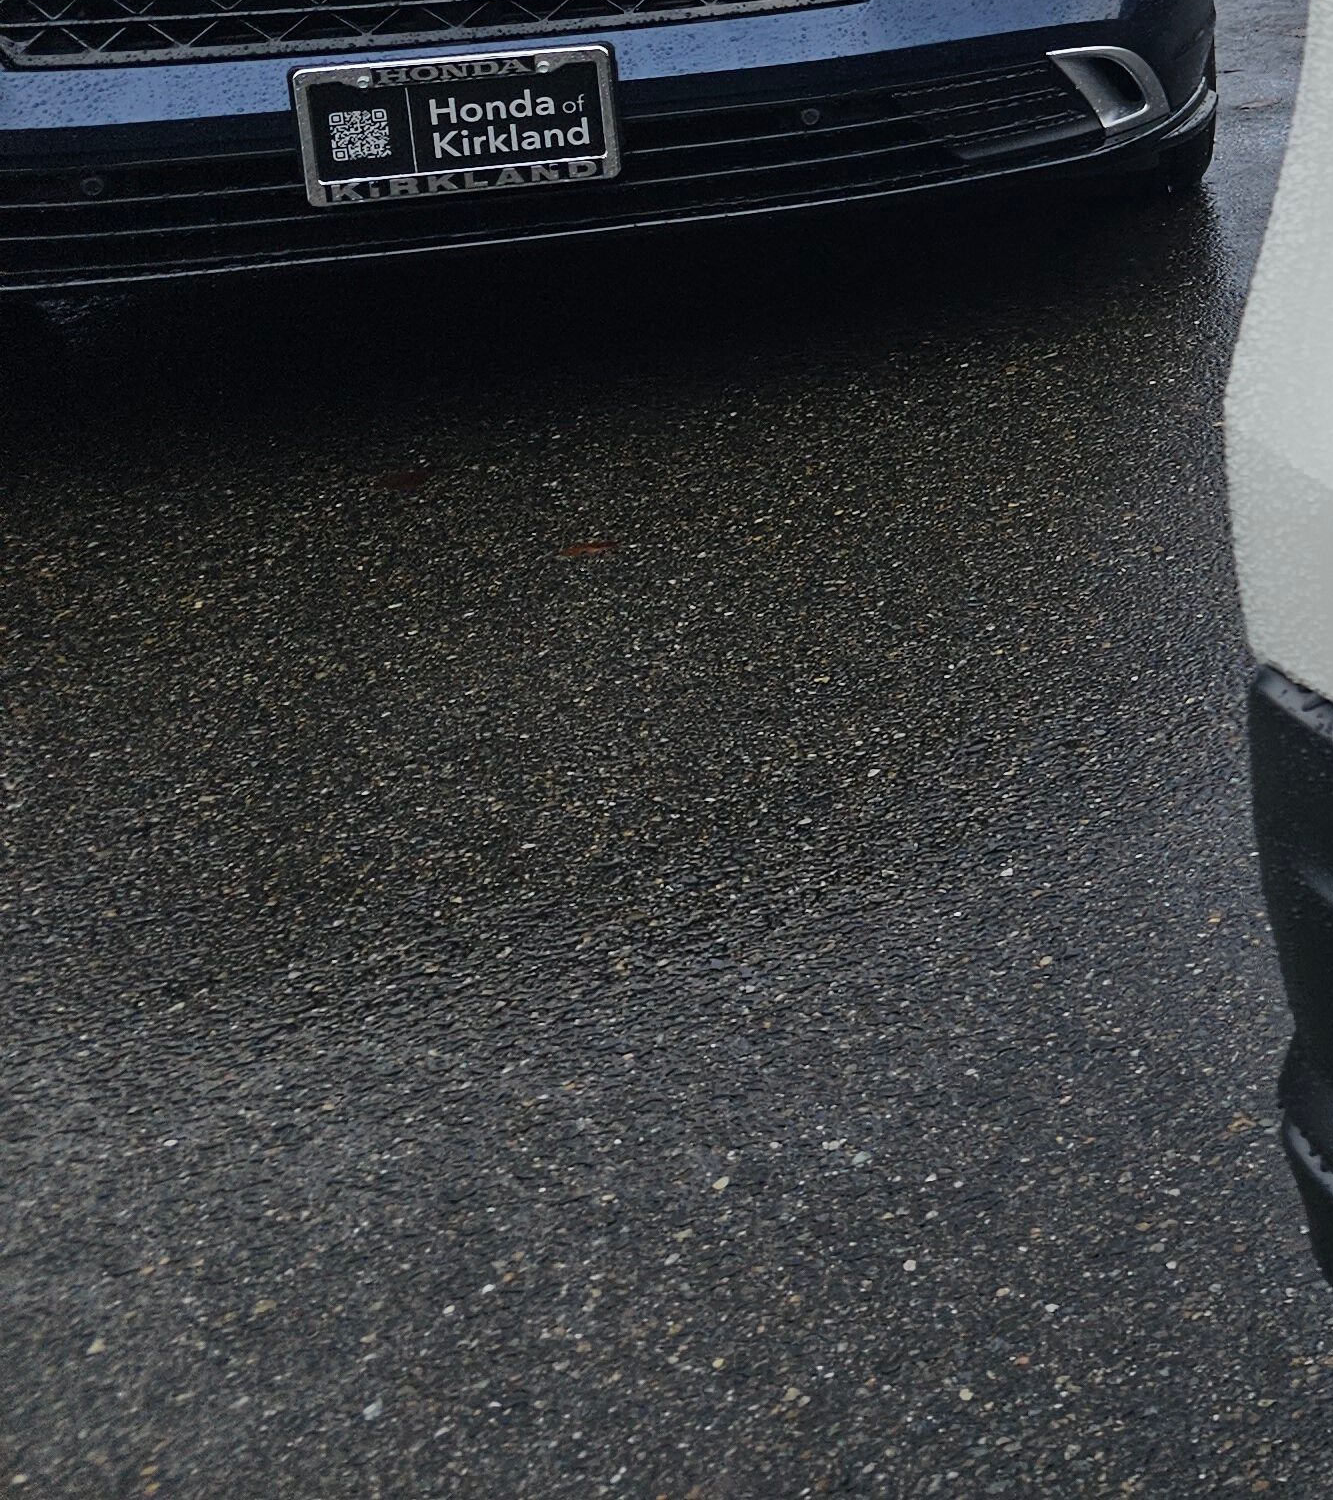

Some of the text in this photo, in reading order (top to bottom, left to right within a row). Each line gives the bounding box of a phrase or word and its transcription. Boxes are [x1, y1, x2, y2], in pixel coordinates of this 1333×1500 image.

[379, 58, 533, 86] HONDA
[429, 88, 586, 126] Honda of
[431, 116, 591, 159] Kirkland
[330, 160, 599, 202] KIRKLAND
